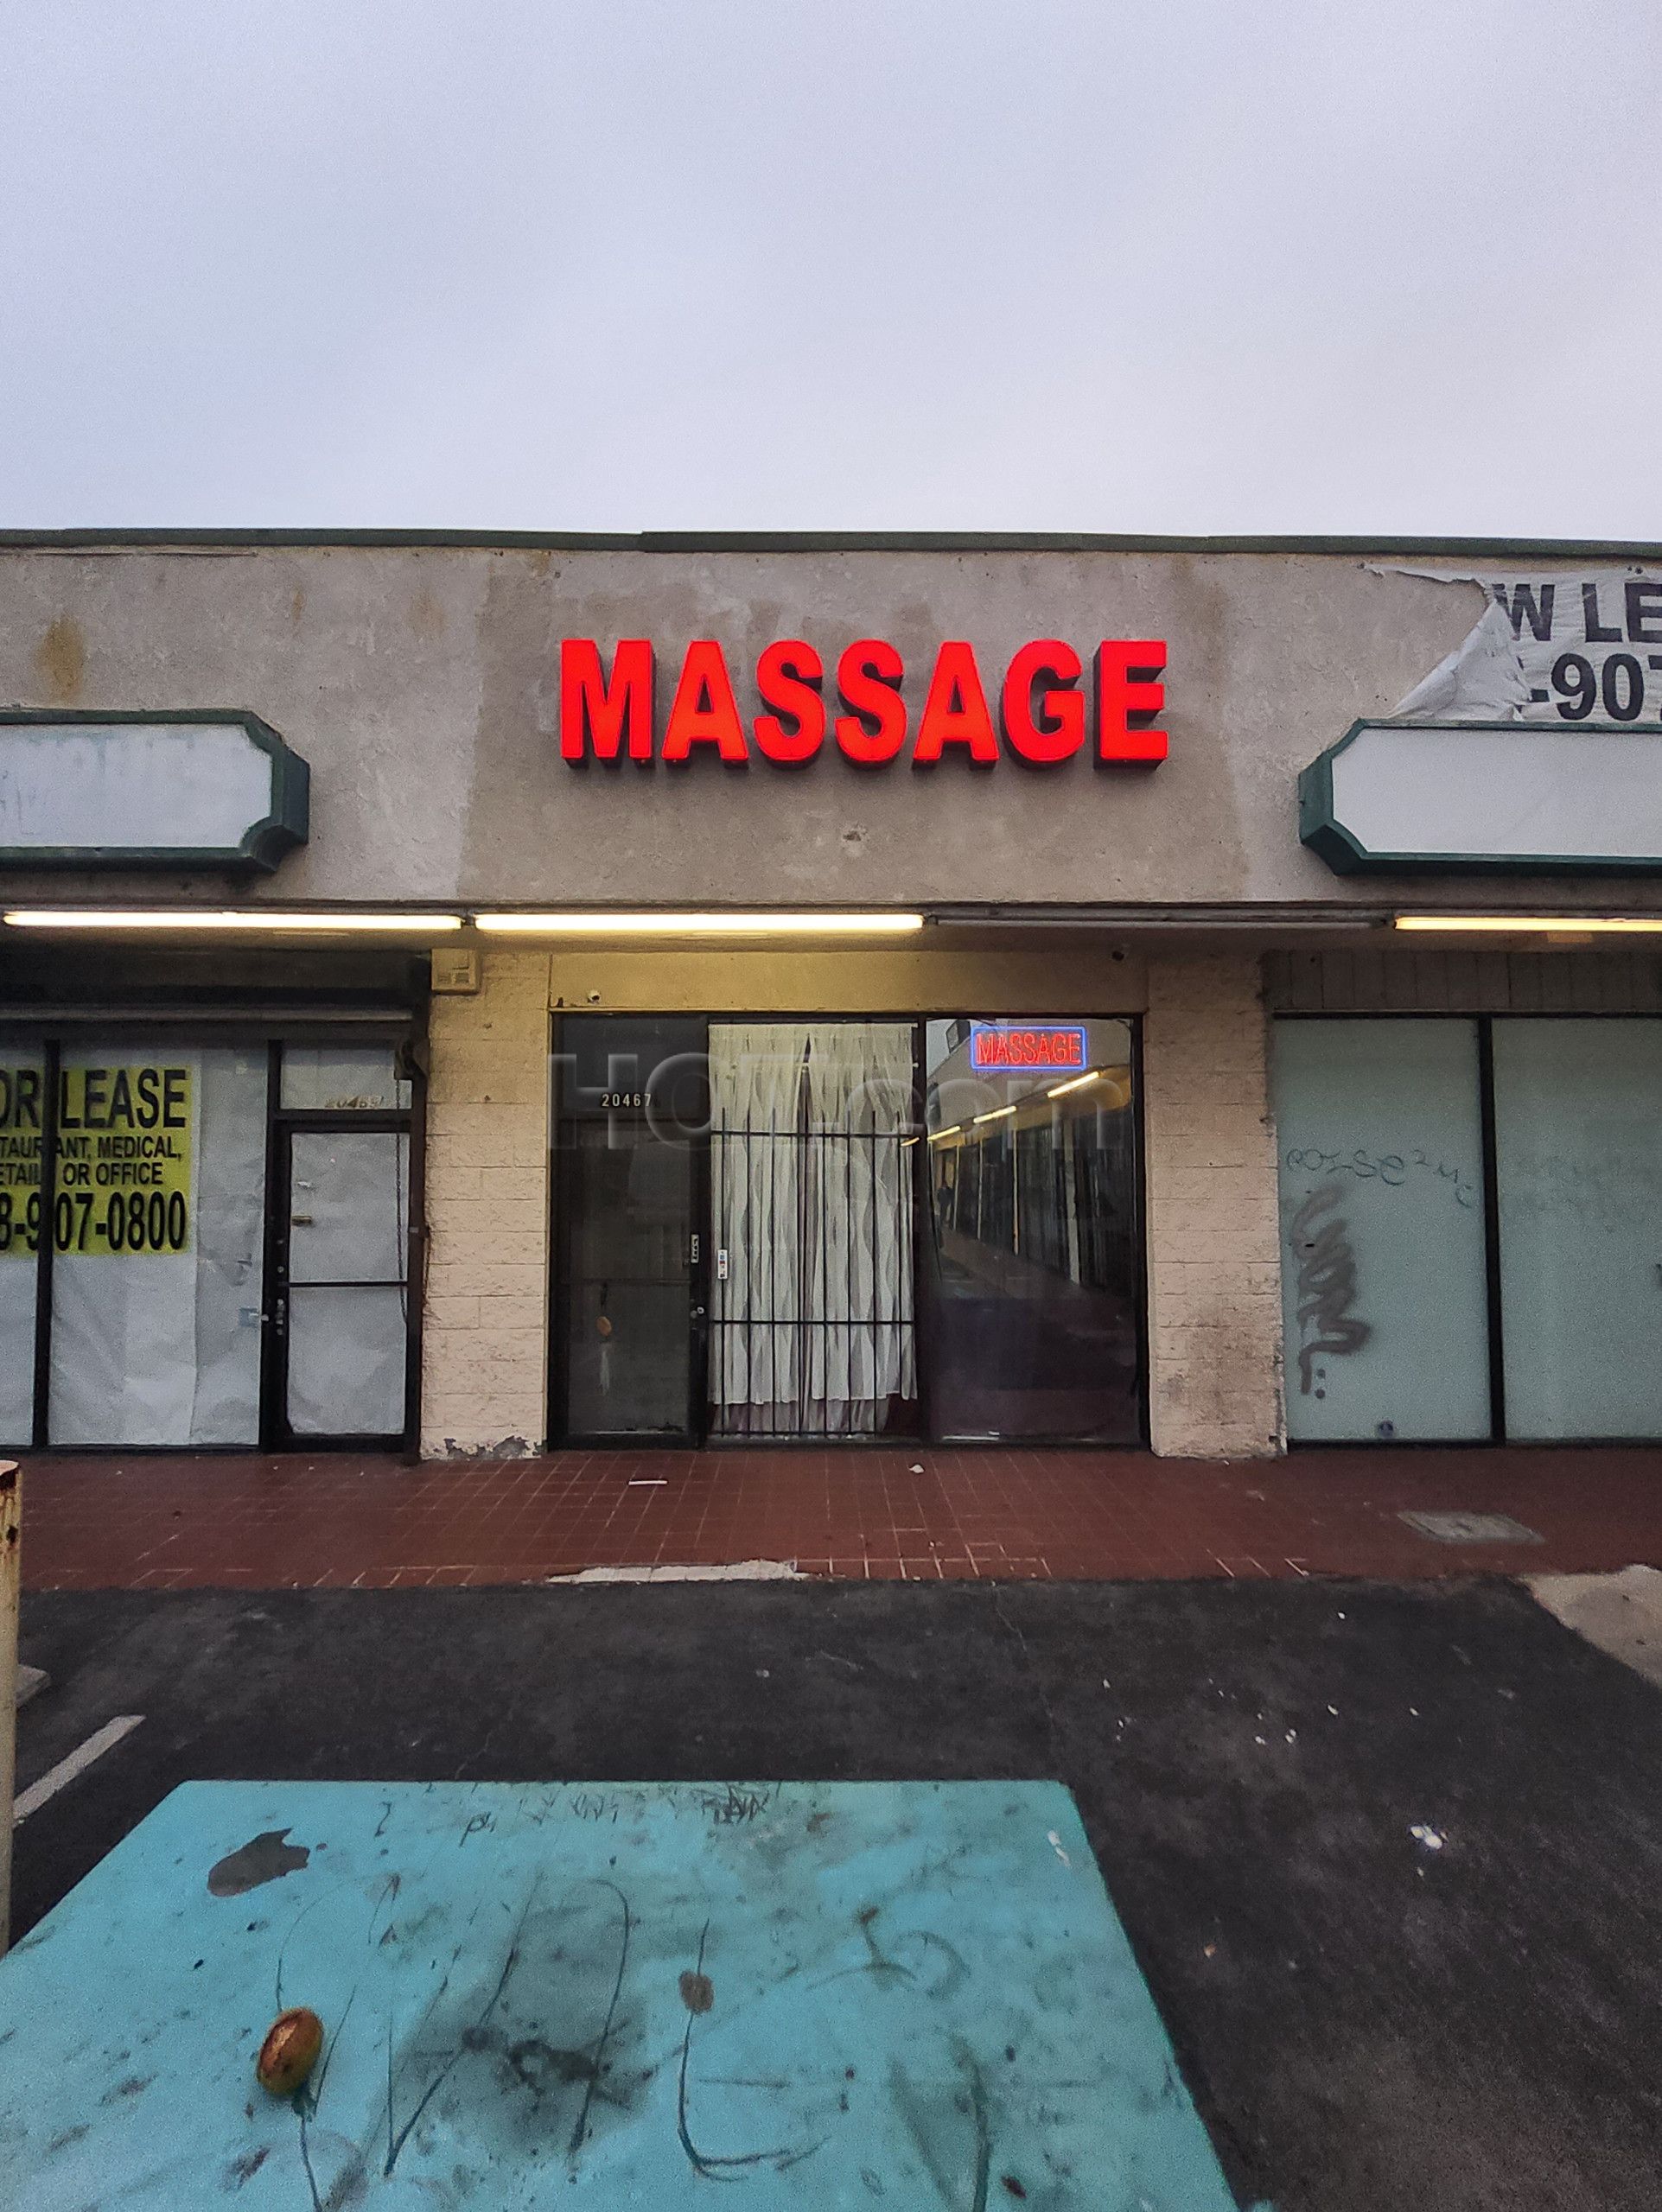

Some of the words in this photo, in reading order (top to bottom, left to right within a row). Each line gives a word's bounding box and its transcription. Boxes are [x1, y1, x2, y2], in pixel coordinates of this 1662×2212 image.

[1492, 583, 1556, 642] W
[1581, 582, 1662, 643] LE
[560, 639, 1168, 768] MASSAGE
[975, 1032, 1082, 1065] MASSAGE
[60, 1068, 186, 1128] LEASE
[602, 1092, 652, 1107] 20467
[98, 1135, 181, 1162] MEDICAL,
[62, 1161, 92, 1185] OR
[96, 1161, 163, 1186] OFFICE
